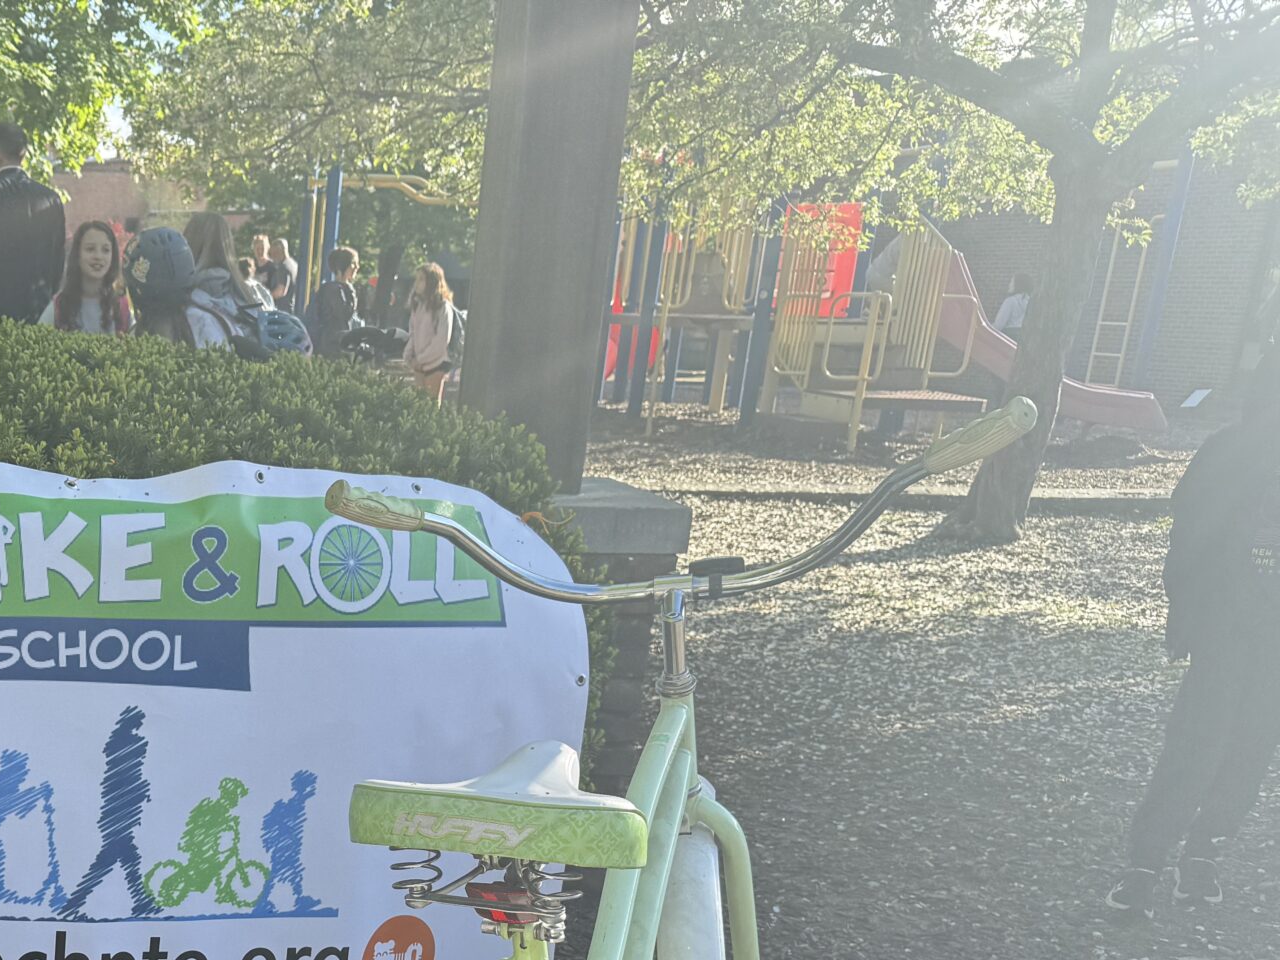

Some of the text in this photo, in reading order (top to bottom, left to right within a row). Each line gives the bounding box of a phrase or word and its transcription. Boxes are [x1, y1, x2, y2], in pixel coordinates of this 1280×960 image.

[182, 524, 240, 605] &
[256, 514, 490, 615] ROLL
[1251, 557, 1277, 567] AME
[391, 811, 537, 849] HUFFY
